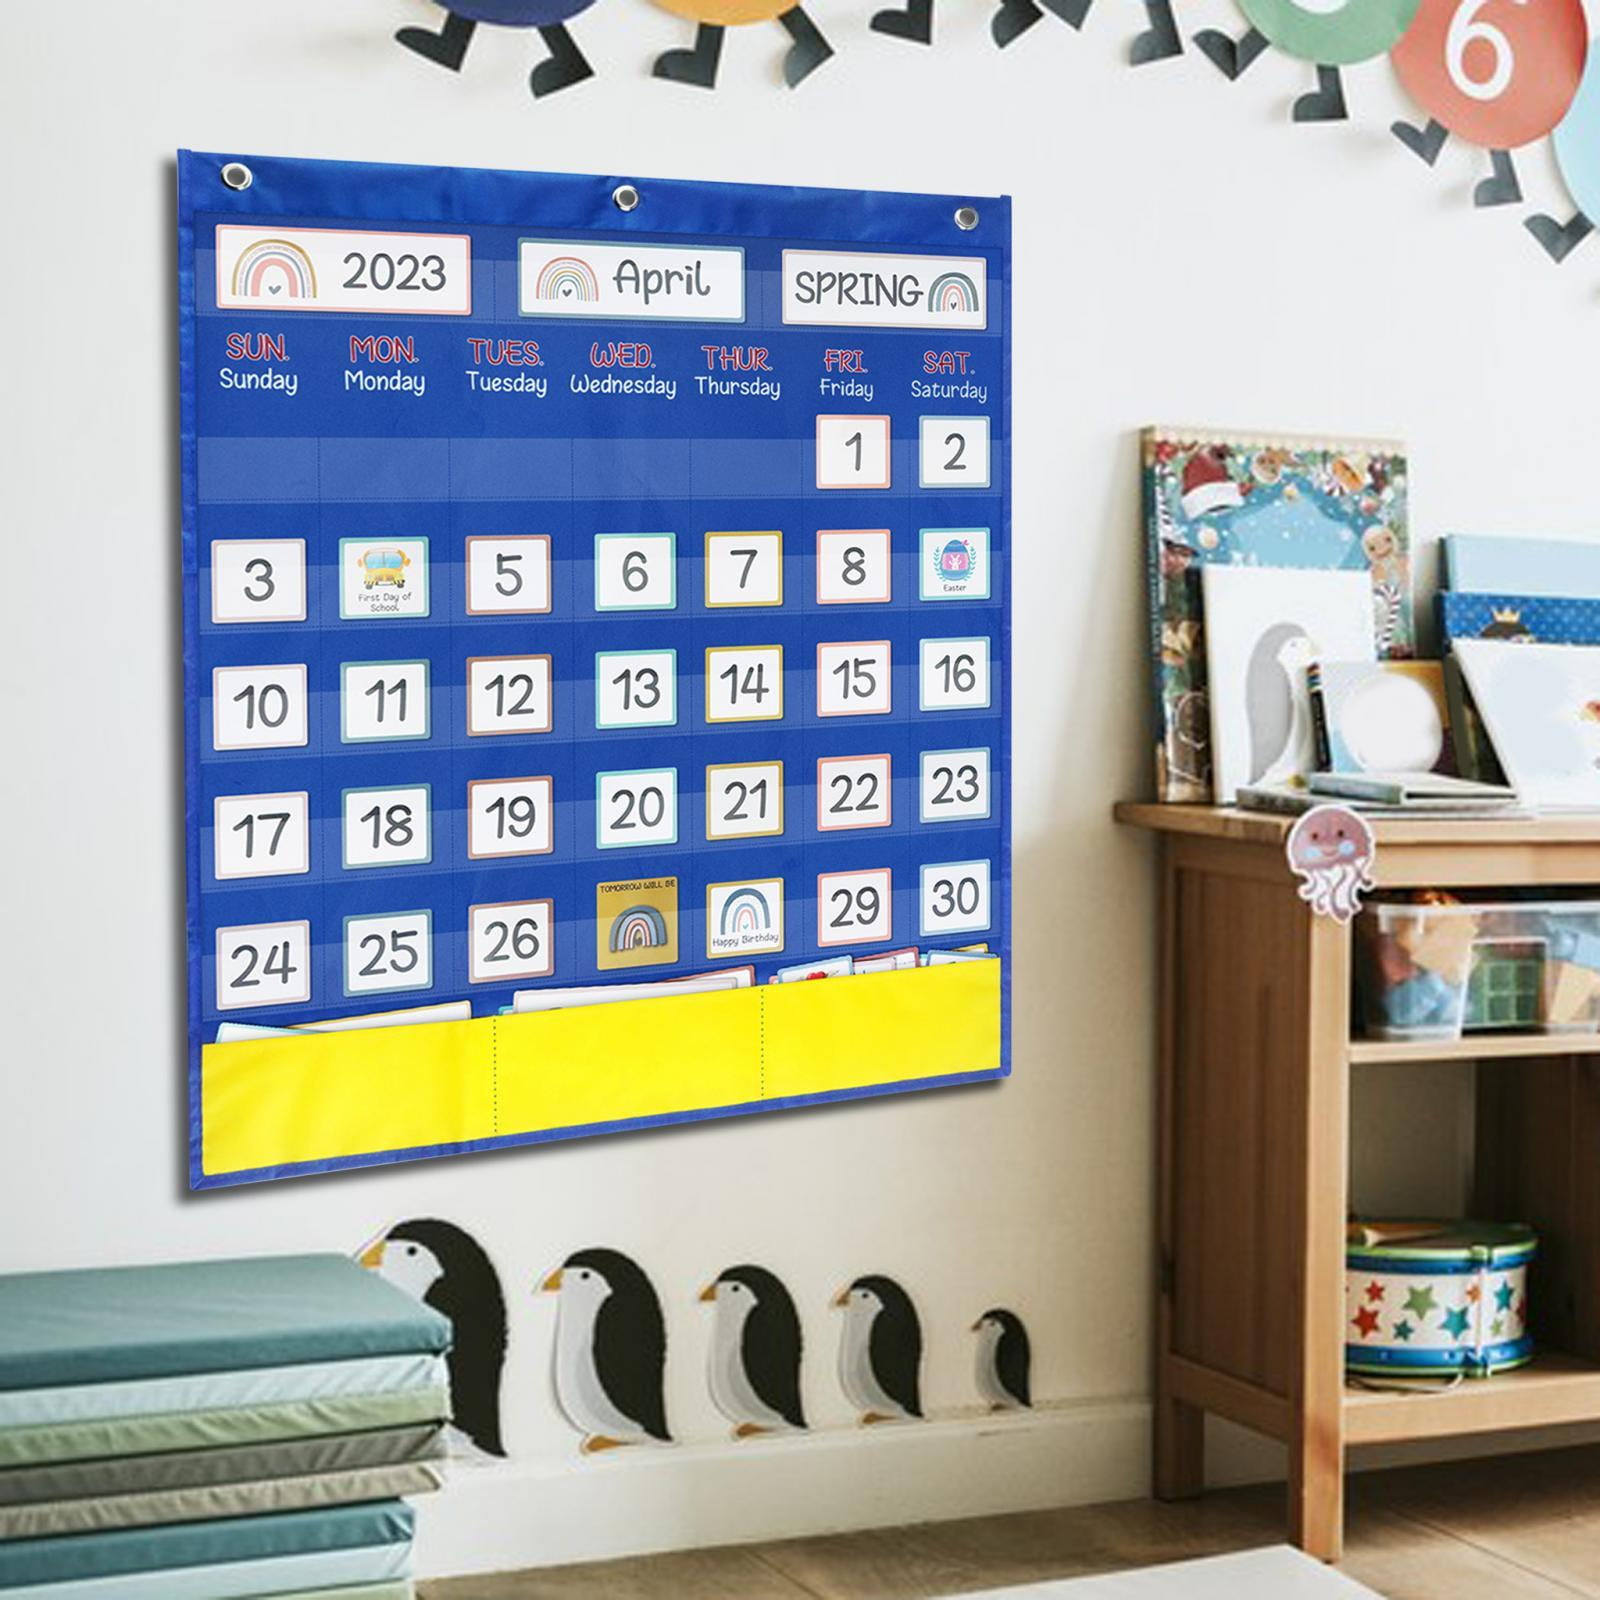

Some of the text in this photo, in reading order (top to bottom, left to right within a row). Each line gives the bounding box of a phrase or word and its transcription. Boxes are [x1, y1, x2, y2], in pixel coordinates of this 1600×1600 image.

[1445, 0, 1526, 101] 6
[343, 253, 445, 290] 2023
[613, 260, 710, 304] April
[796, 272, 923, 306] SPRING
[226, 333, 290, 361] SUN.
[349, 336, 419, 363] MON.
[467, 337, 545, 366] TUES.
[590, 341, 656, 369] WED.
[701, 345, 773, 371] THUR.
[823, 349, 868, 373] FRI.
[923, 351, 976, 376] SAT.
[219, 368, 298, 396] Sunday
[344, 371, 426, 397] Monday
[466, 371, 548, 398] Tuesday
[570, 374, 677, 400] Wednesday
[695, 376, 781, 400] Thursday
[819, 379, 874, 401] Friday
[911, 381, 988, 404] Saturday
[846, 433, 861, 470] 1
[944, 433, 966, 470] 2
[245, 559, 274, 601] 3
[496, 554, 522, 596] 5
[623, 552, 647, 591] 6
[730, 550, 757, 588] 7
[842, 547, 865, 585] 8
[358, 592, 412, 602] First Day of
[943, 584, 967, 592] Easter
[370, 603, 400, 612] School
[613, 668, 660, 710] 13
[720, 664, 769, 704] 14
[833, 658, 875, 698] 15
[936, 655, 975, 692] 16
[234, 684, 287, 728] 10
[366, 679, 406, 722] 11
[485, 674, 534, 716] 12
[724, 779, 766, 820] 21
[830, 773, 878, 812] 22
[932, 765, 978, 804] 23
[361, 805, 413, 848] 18
[486, 796, 535, 838] 19
[611, 787, 664, 829] 20
[233, 813, 290, 857] 17
[599, 882, 642, 893] TOMORROW
[933, 877, 979, 916] 30
[831, 887, 879, 927] 29
[359, 930, 417, 976] 25
[484, 918, 539, 961] 26
[713, 933, 779, 948] Happy Birthday
[231, 941, 297, 987] 24
